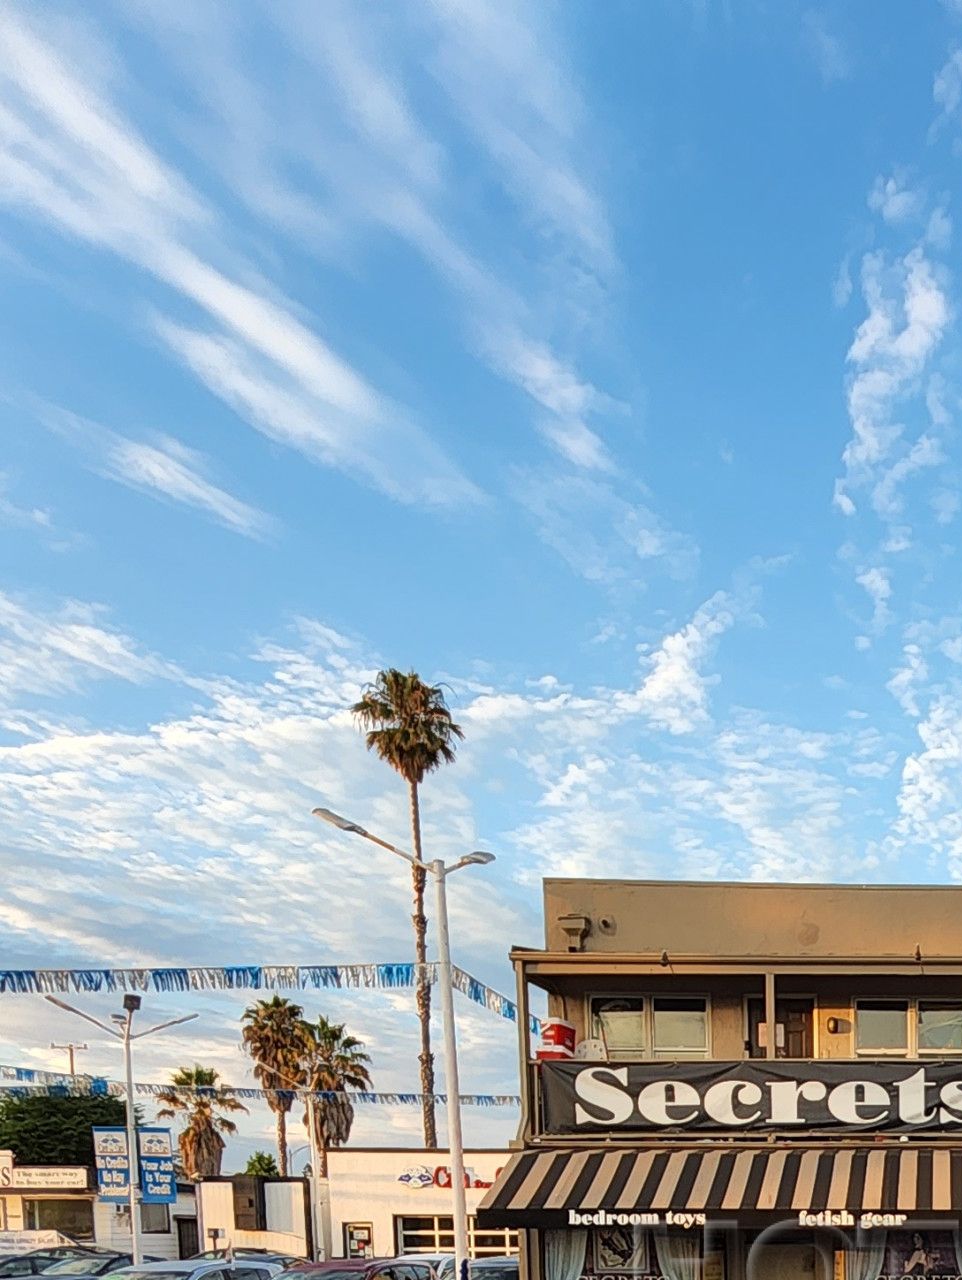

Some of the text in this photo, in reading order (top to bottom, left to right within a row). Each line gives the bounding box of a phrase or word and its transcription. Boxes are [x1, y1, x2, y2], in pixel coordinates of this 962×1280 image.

[140, 1159, 159, 1171] Your
[153, 1171, 172, 1183] Your
[568, 1210, 706, 1228] bedroom toys
[799, 1210, 908, 1229] fetish gear
